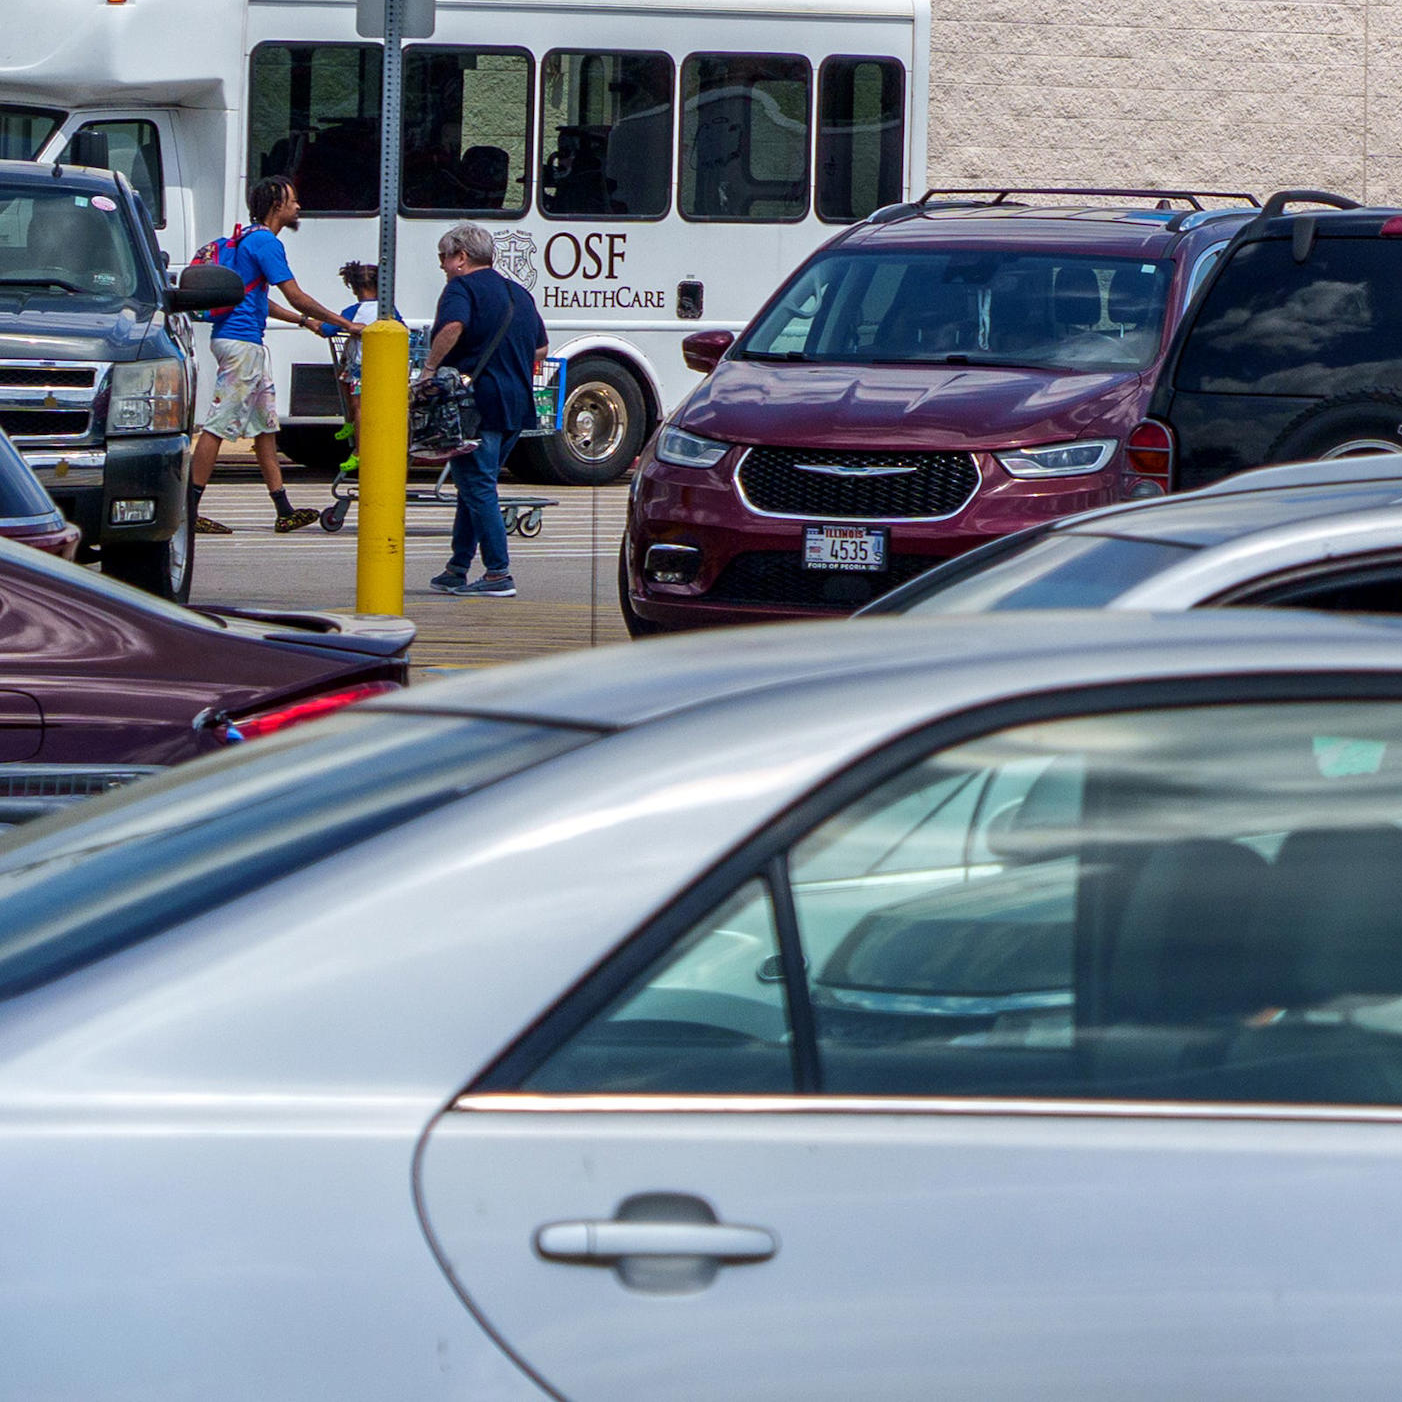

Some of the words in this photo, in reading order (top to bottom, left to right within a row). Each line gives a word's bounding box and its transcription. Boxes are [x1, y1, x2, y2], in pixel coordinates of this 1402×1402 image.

[544, 231, 627, 280] OSF
[543, 286, 665, 308] HEALTHCARE
[825, 529, 864, 538] ILLINOIS
[830, 539, 869, 561] 4535
